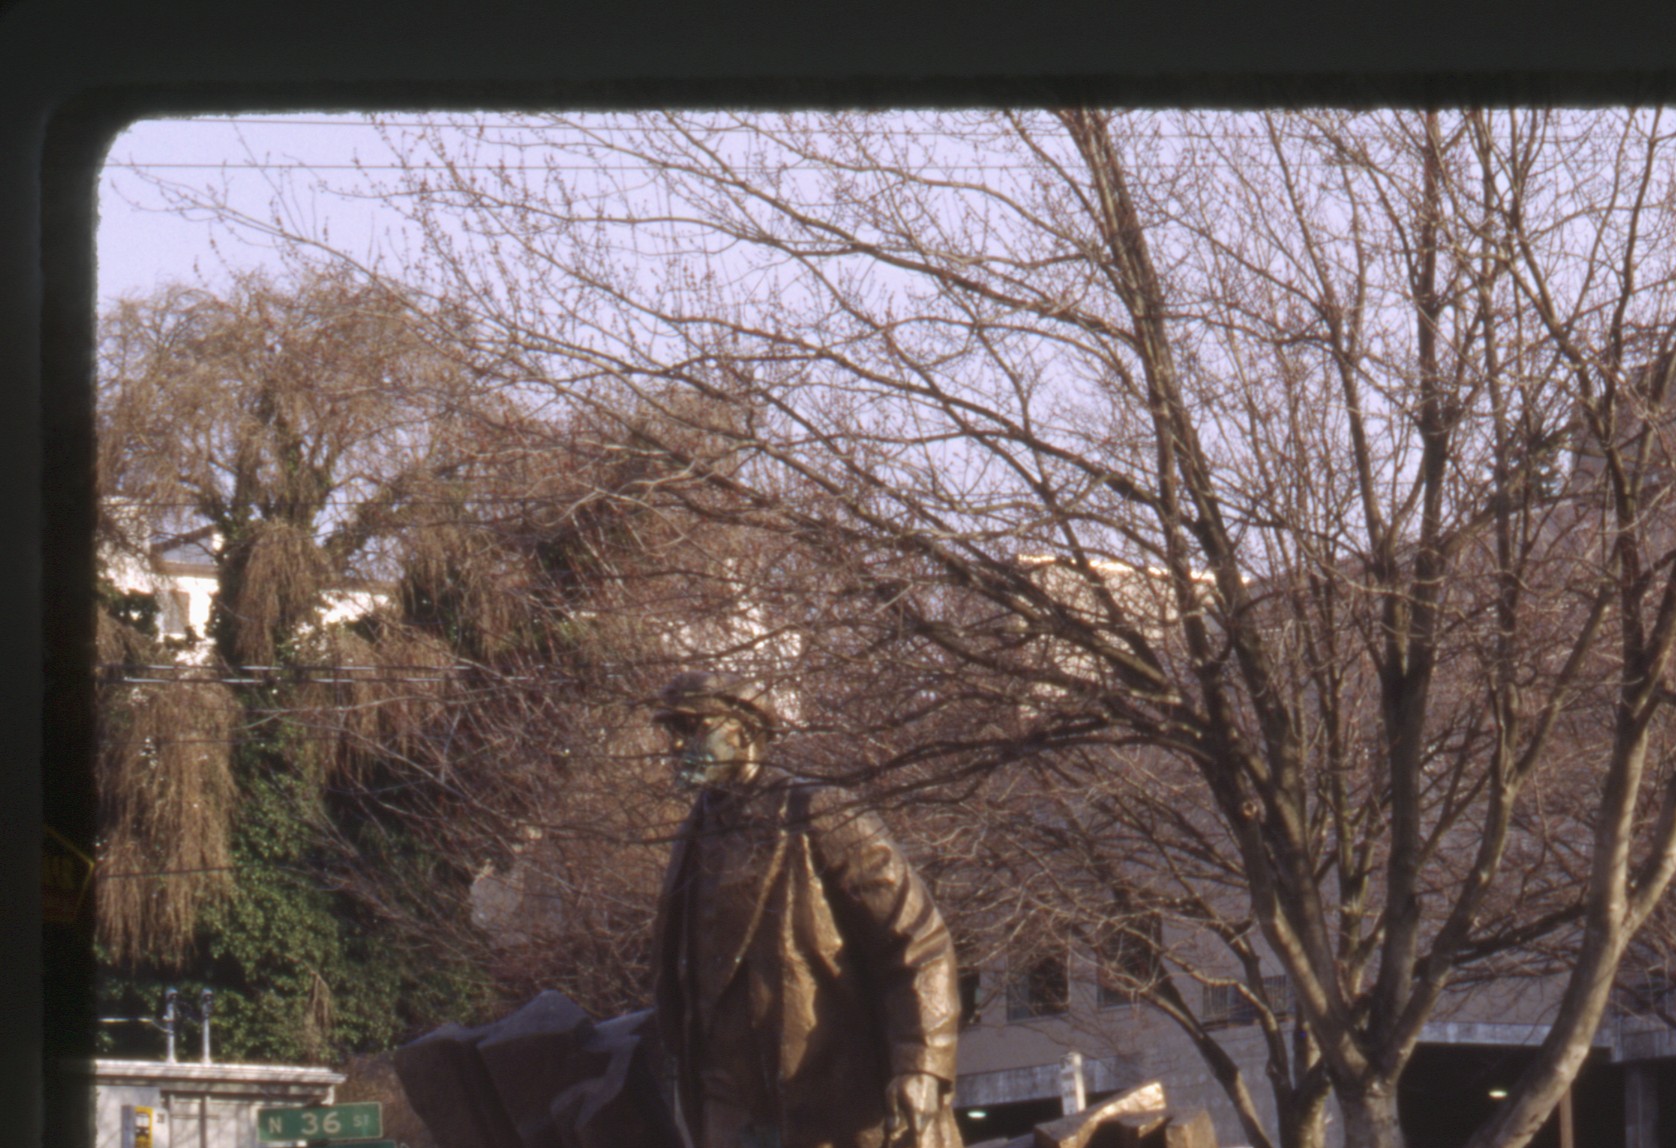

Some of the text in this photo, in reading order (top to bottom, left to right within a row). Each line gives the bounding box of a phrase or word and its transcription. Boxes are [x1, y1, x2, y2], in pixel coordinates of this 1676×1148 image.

[268, 1111, 370, 1135] N 36 ST
